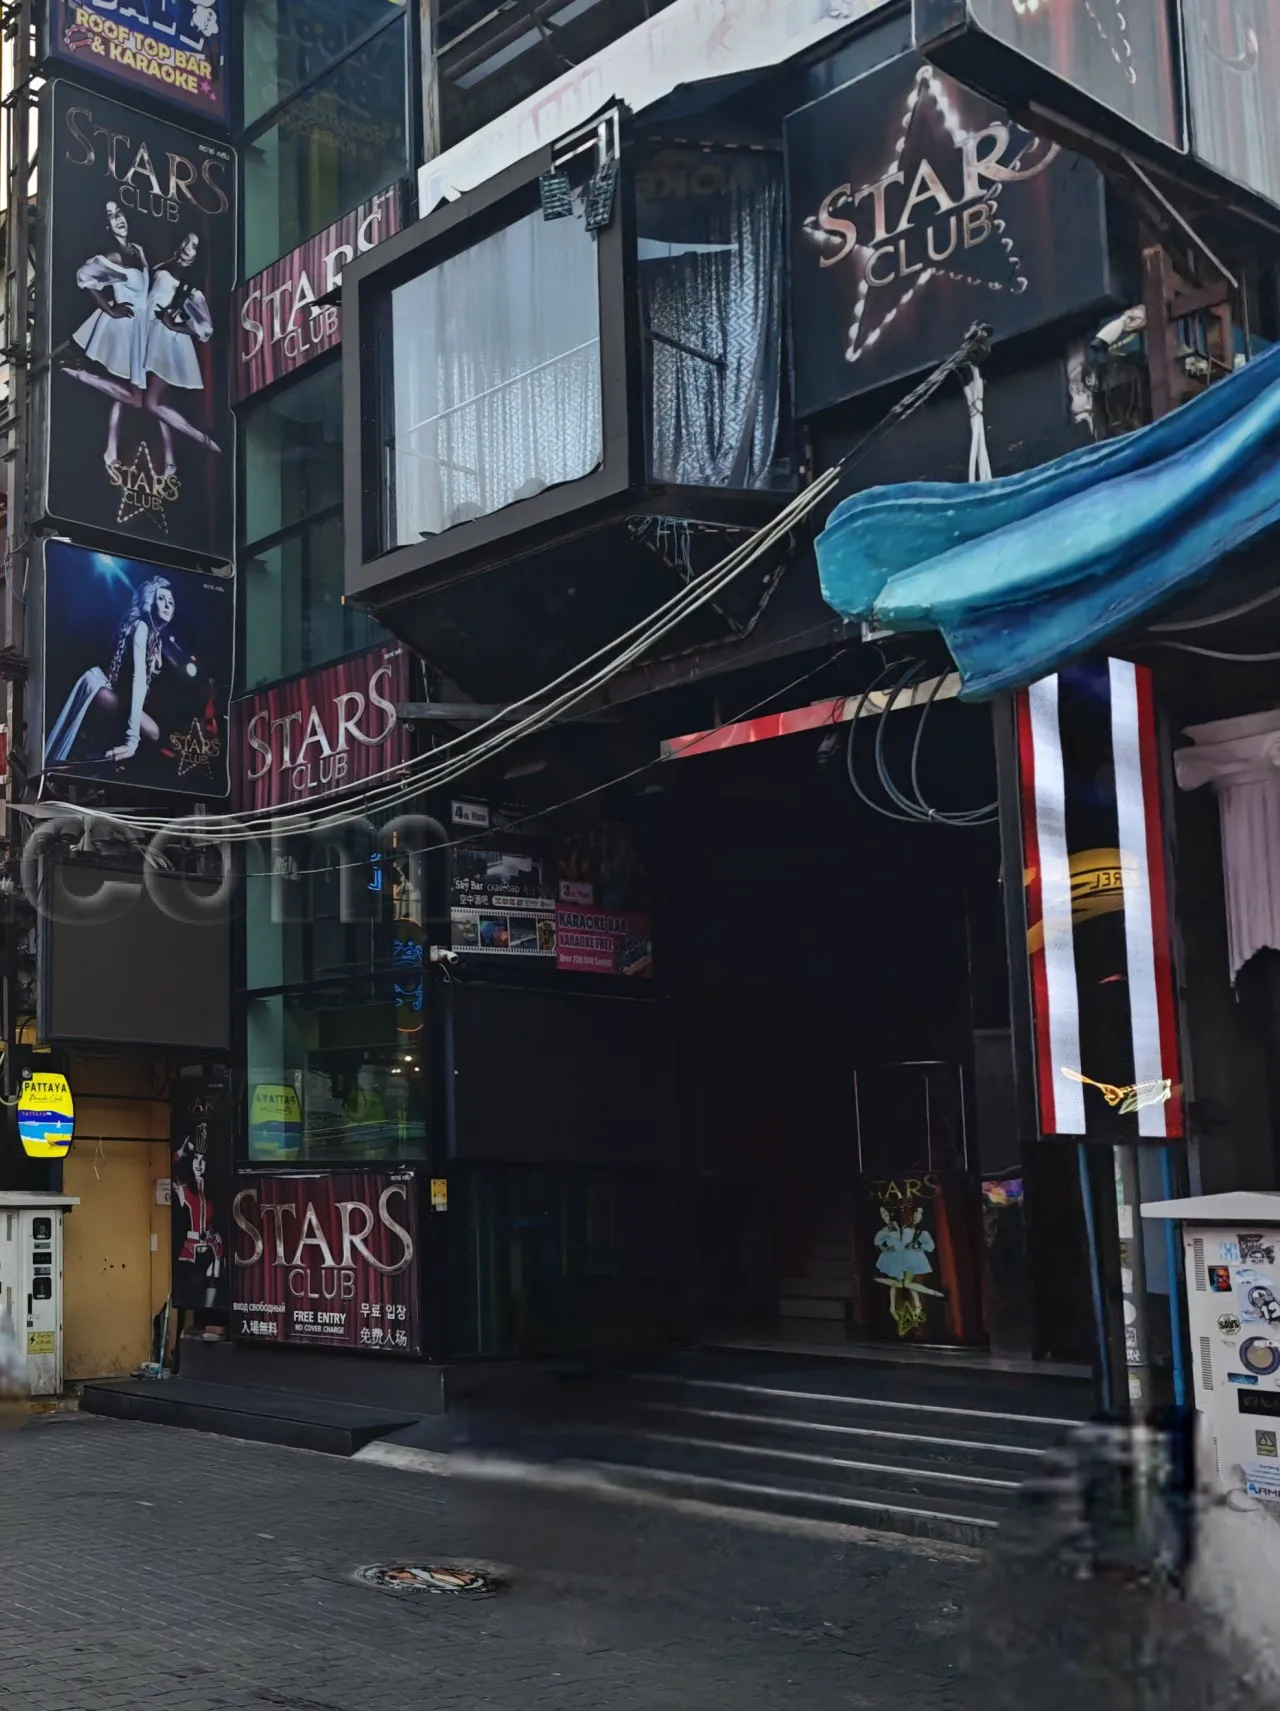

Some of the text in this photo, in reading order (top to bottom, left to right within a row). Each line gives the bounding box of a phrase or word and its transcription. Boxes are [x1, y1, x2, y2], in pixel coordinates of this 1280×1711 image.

[76, 8, 131, 41] ROOF
[132, 33, 171, 61] TOP
[175, 52, 212, 79] BAR
[91, 36, 199, 94] & KARAOKE
[66, 106, 229, 214] STARS
[119, 185, 180, 223] CLUB
[818, 124, 1062, 268] STAR
[865, 203, 992, 287] CLUB
[283, 307, 339, 357] CLUB
[110, 459, 179, 501] STARS
[124, 490, 161, 510] CLUB
[247, 664, 397, 783] STARS
[172, 733, 221, 757] STARS
[292, 753, 349, 791] CLUB
[558, 911, 629, 934] KARAOKE BAR
[24, 1082, 67, 1093] PATTAYA
[232, 1184, 414, 1277] STARS
[288, 1269, 356, 1301] CLUB
[241, 1319, 278, 1336] 入場無料
[293, 1310, 346, 1326] FREE ENTRY
[295, 1324, 345, 1335] NO COVER CHARGE
[360, 1303, 407, 1321] 무료 입장
[359, 1328, 408, 1347] 免费入场
